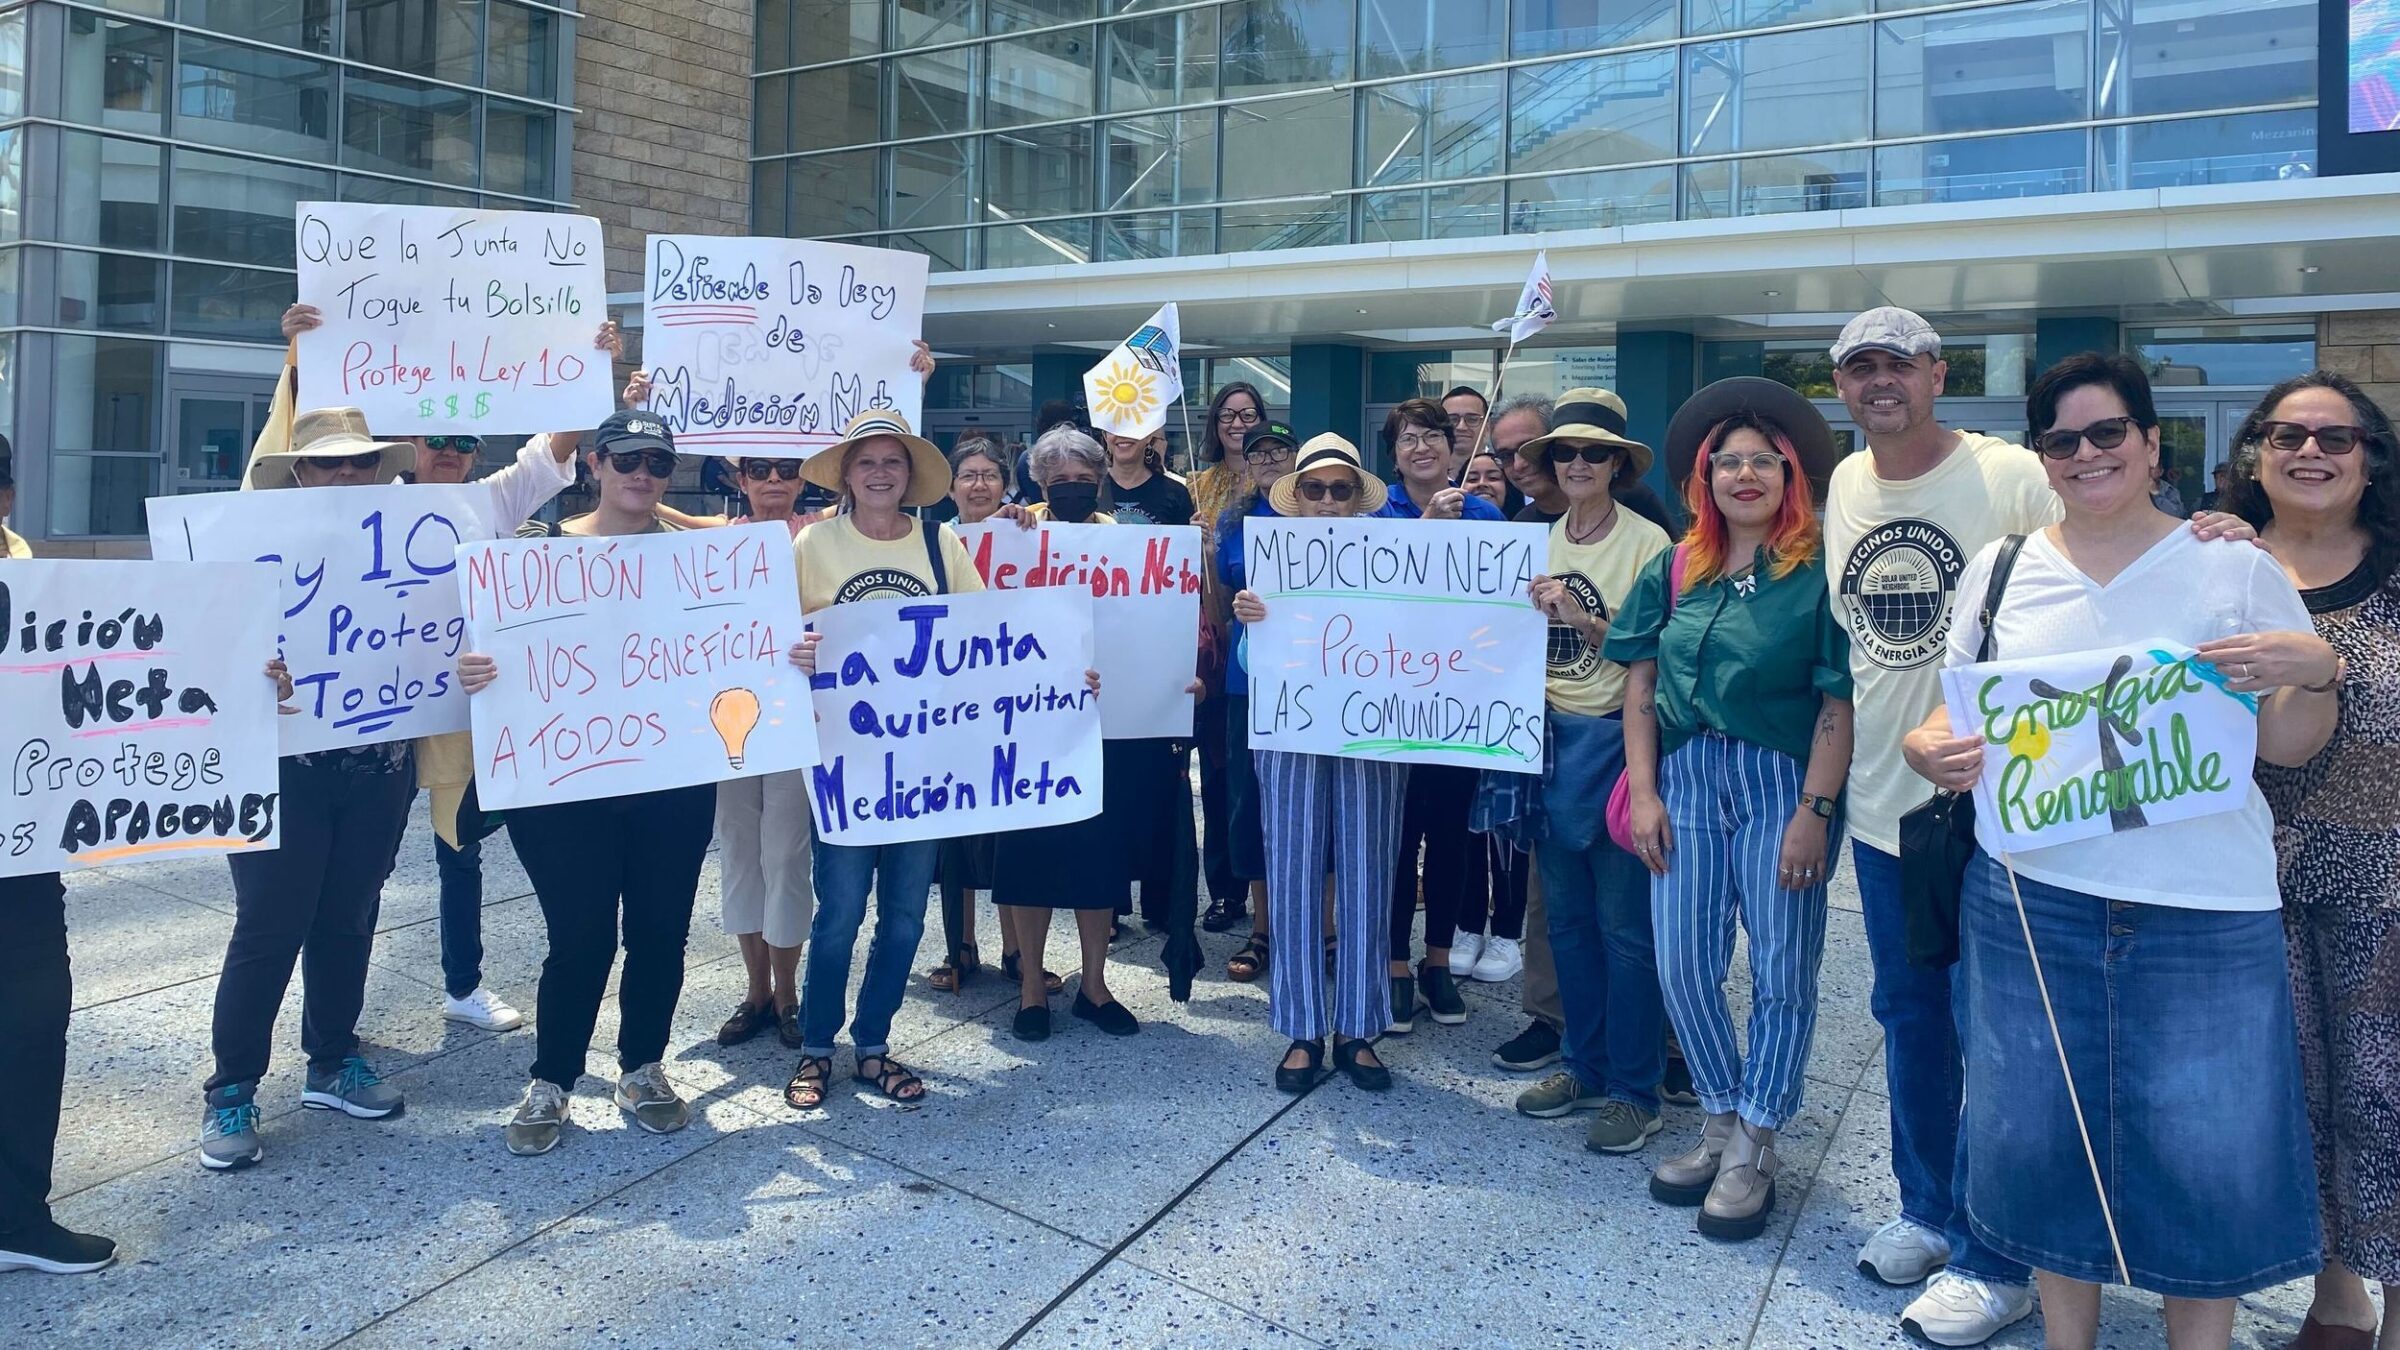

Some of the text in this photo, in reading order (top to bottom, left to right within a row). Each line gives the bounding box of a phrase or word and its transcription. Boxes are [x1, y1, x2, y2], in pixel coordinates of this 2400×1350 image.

[2251, 126, 2317, 141] Mezzanin
[300, 214, 587, 267] Que la Junta No
[442, 278, 471, 314] tu
[486, 279, 582, 318] Bolsillo
[651, 239, 896, 321] Defiende la ley
[766, 314, 805, 352] de
[342, 336, 584, 395] Protege la Ley 10
[647, 365, 820, 434] Medición
[361, 510, 461, 581] 10
[673, 536, 770, 600] NETA
[1140, 537, 1200, 595] Neta
[1446, 536, 1533, 597] NETA
[1846, 525, 1960, 577] VECINOS UNIDOS
[0, 580, 163, 653] ición
[837, 573, 928, 605] ECINOS UNID
[328, 604, 464, 657] Proteg
[894, 604, 1047, 679] Junta
[1321, 613, 1471, 688] Protege
[1851, 607, 1866, 631] POR
[1863, 633, 1873, 651] LA
[61, 661, 218, 729] Neta
[294, 665, 450, 719] Todos
[527, 638, 597, 703] NOS
[993, 684, 1094, 736] quitar
[1252, 677, 1315, 736] LAS
[14, 738, 224, 796] Protege
[490, 712, 667, 779] A TODOS
[1999, 713, 2231, 833] Renovable
[813, 742, 1082, 833] Medición Neta
[59, 793, 279, 853] APAGONES
